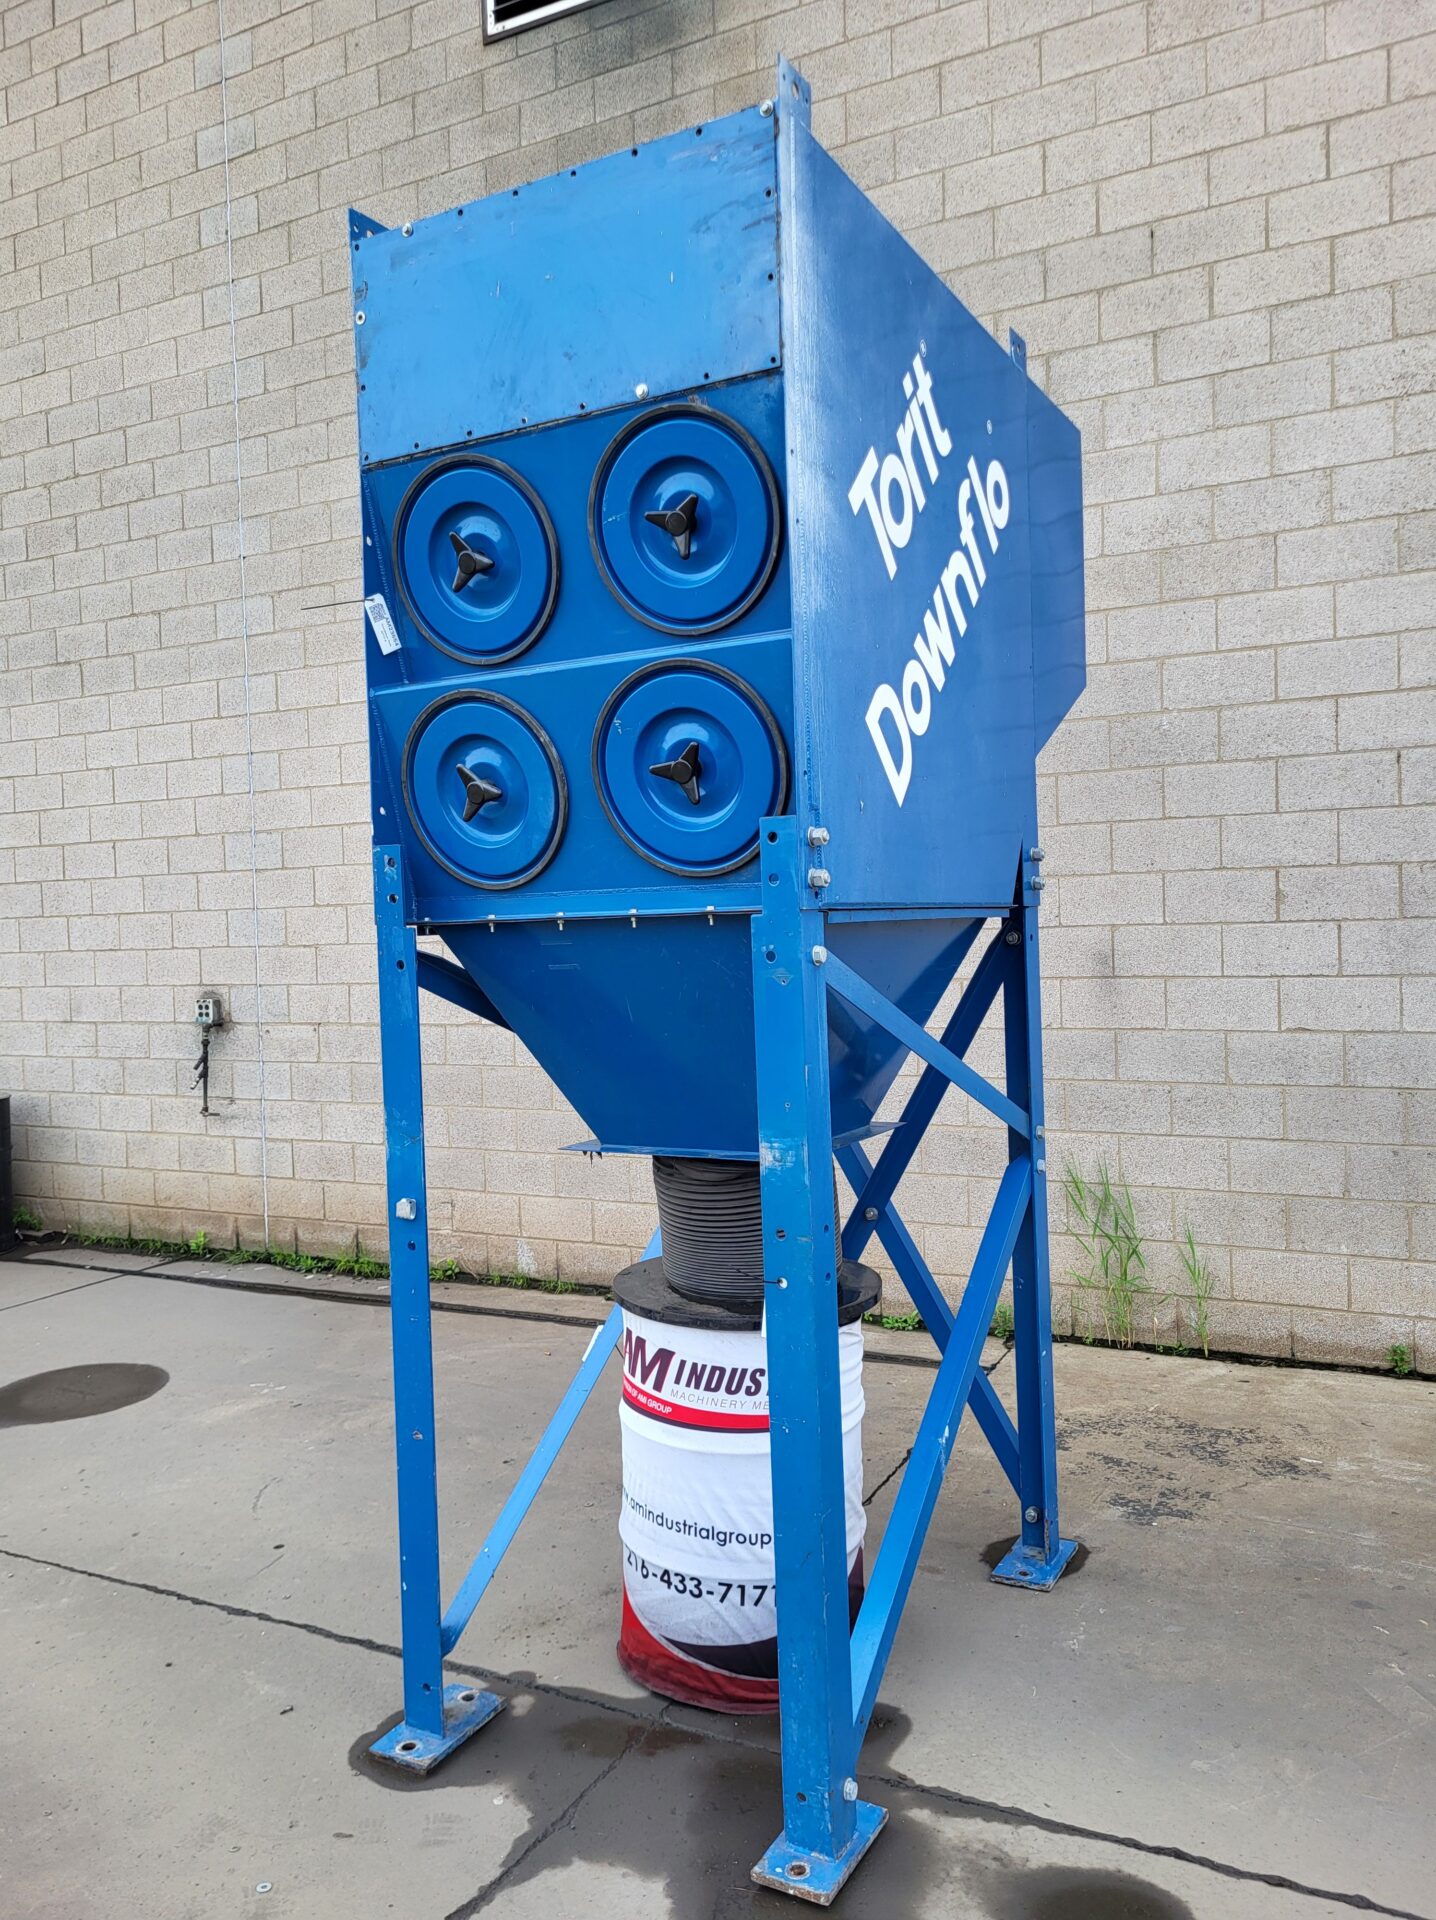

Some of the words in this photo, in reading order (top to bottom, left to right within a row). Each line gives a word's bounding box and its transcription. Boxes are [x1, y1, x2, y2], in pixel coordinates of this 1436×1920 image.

[848, 352, 953, 582] Torit
[865, 455, 1011, 809] Downflo
[624, 1326, 676, 1393] AM
[673, 1358, 769, 1397] INDUS
[647, 1398, 673, 1414] GROUP
[670, 1388, 747, 1409] MACHINERY
